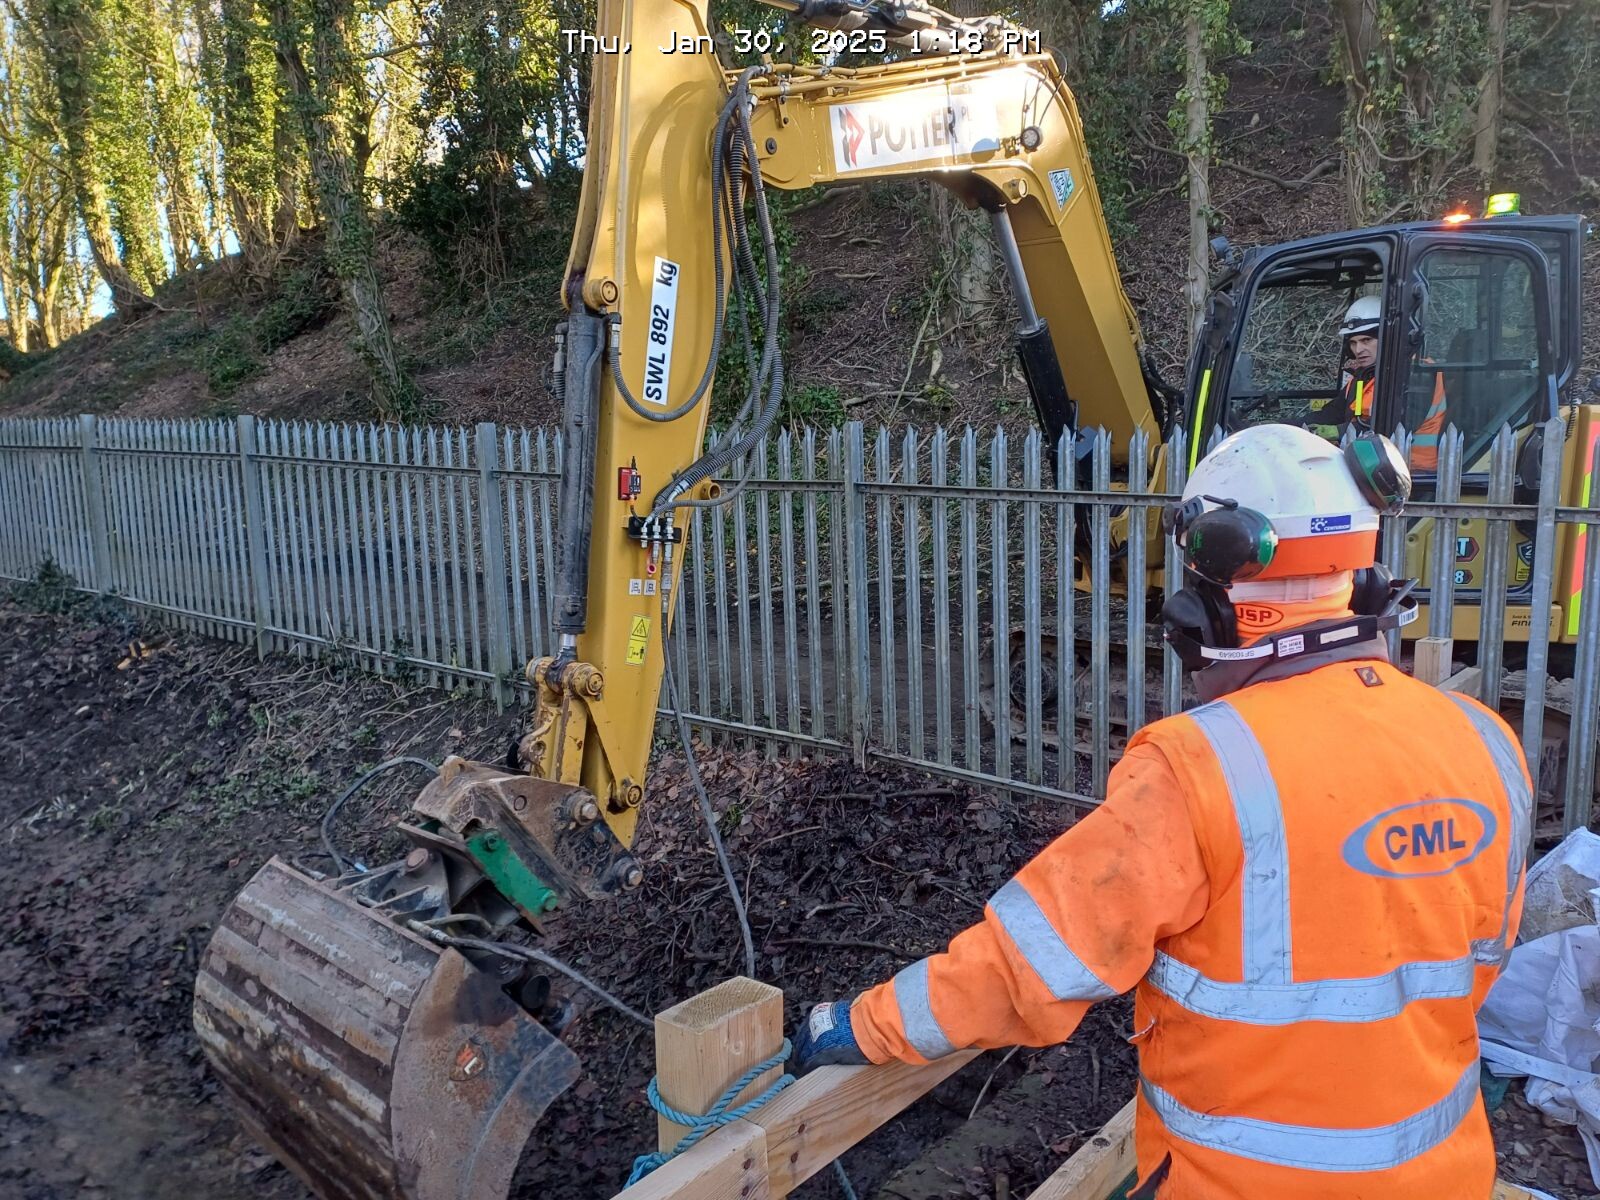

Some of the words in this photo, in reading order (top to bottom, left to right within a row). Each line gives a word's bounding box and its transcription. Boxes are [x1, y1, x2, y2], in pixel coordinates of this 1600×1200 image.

[655, 261, 678, 287] kg
[650, 304, 670, 346] 892
[645, 352, 666, 401] SWL
[1384, 817, 1466, 861] CML
